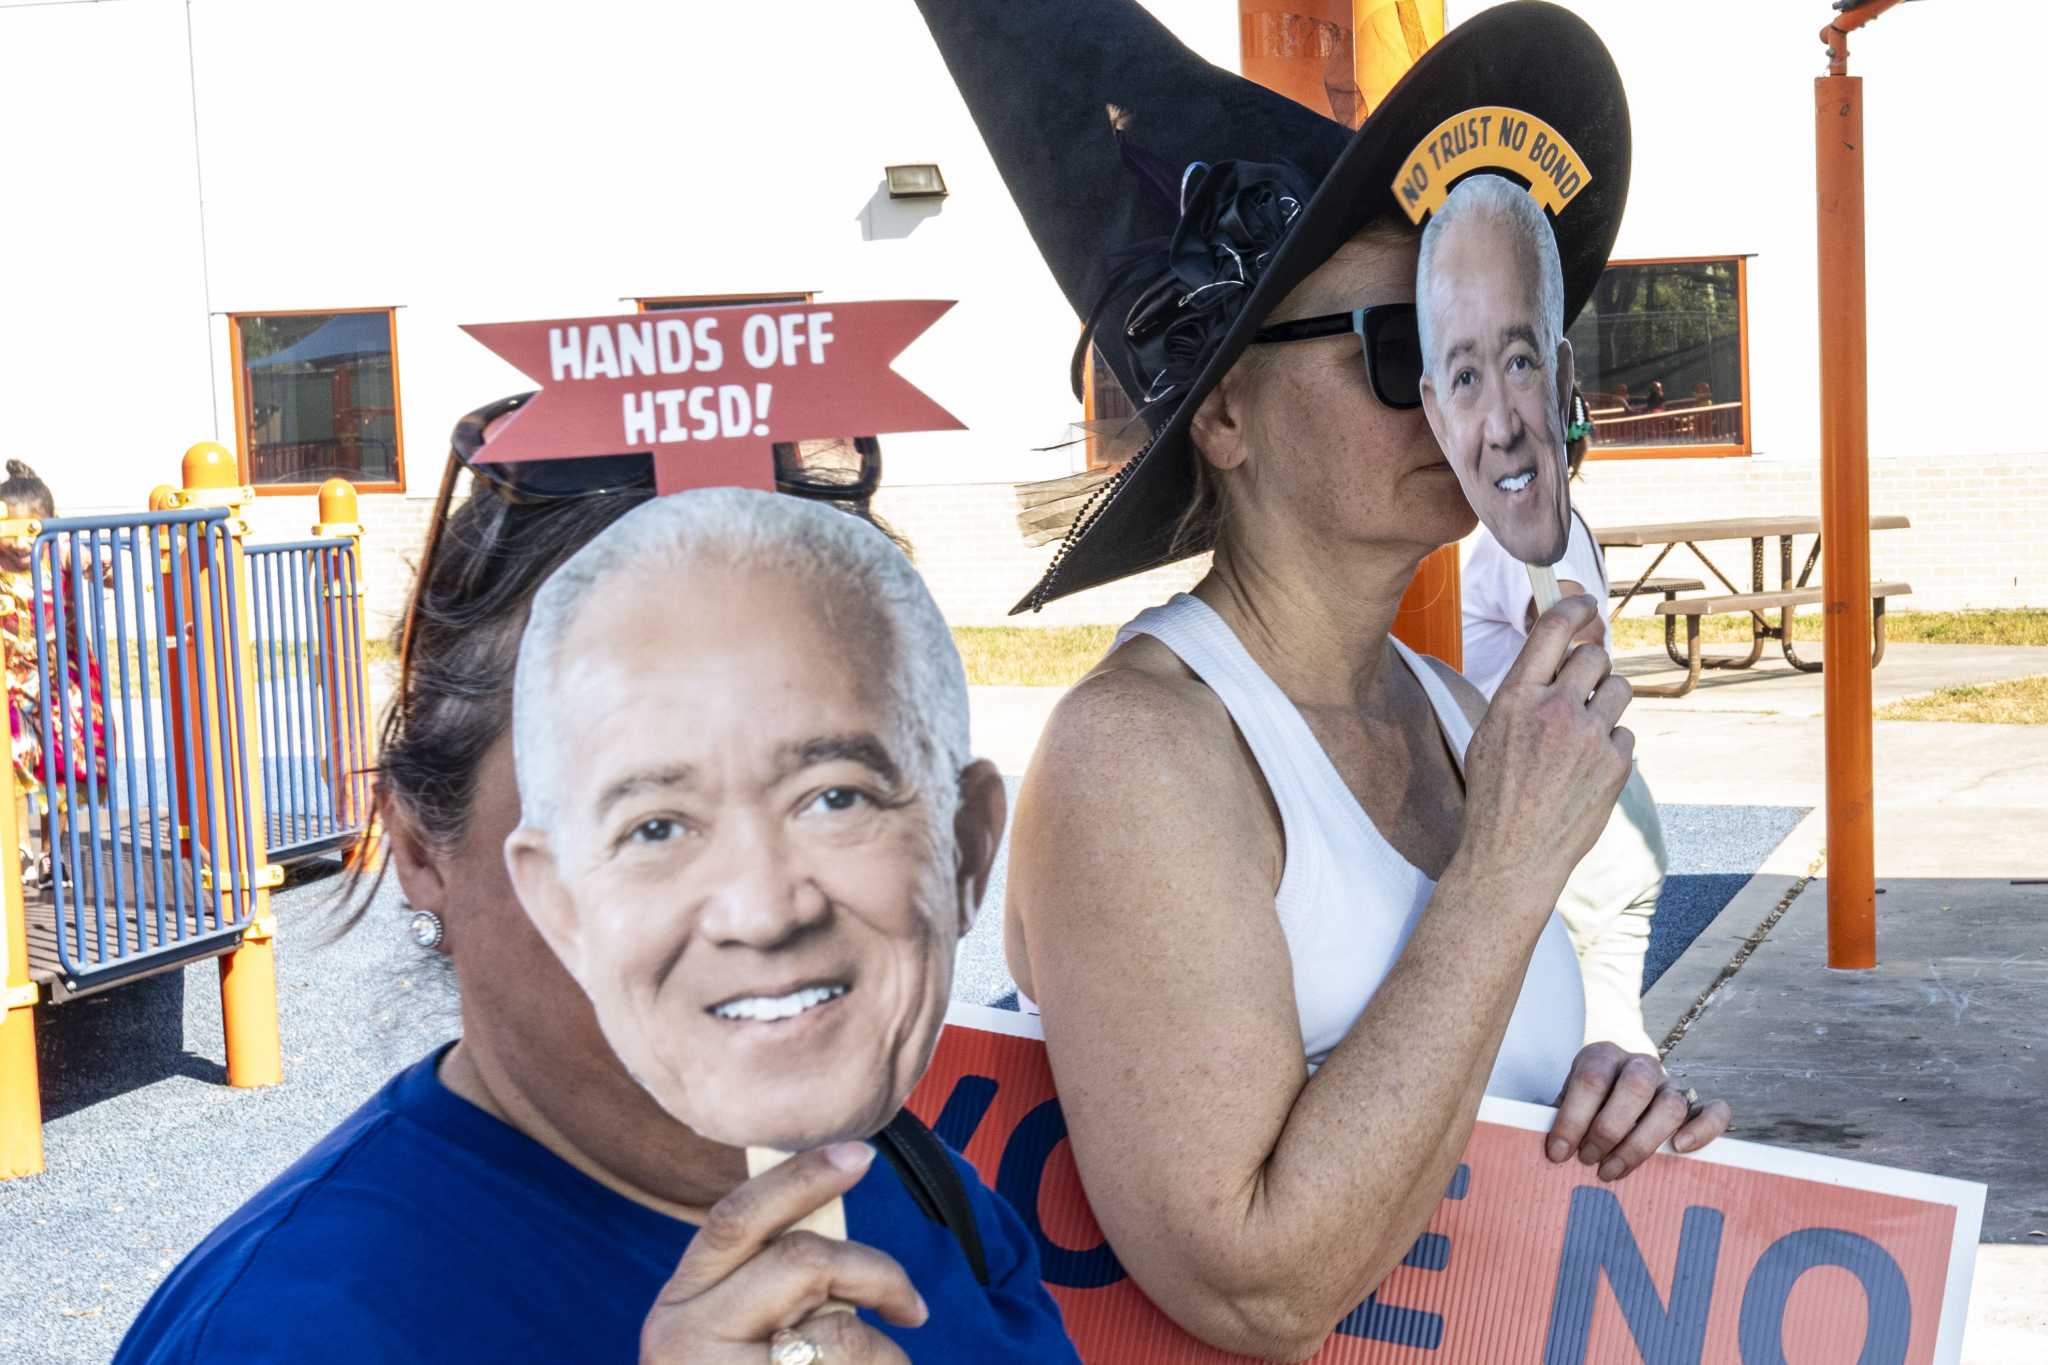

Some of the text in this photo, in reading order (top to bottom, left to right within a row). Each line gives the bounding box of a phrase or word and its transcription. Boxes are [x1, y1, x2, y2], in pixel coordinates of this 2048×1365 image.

[1401, 115, 1581, 209] NO TRUST NO BOND
[548, 311, 835, 381] HANDS OFF
[622, 383, 773, 446] HISD!
[1543, 1185, 1912, 1365] NO
